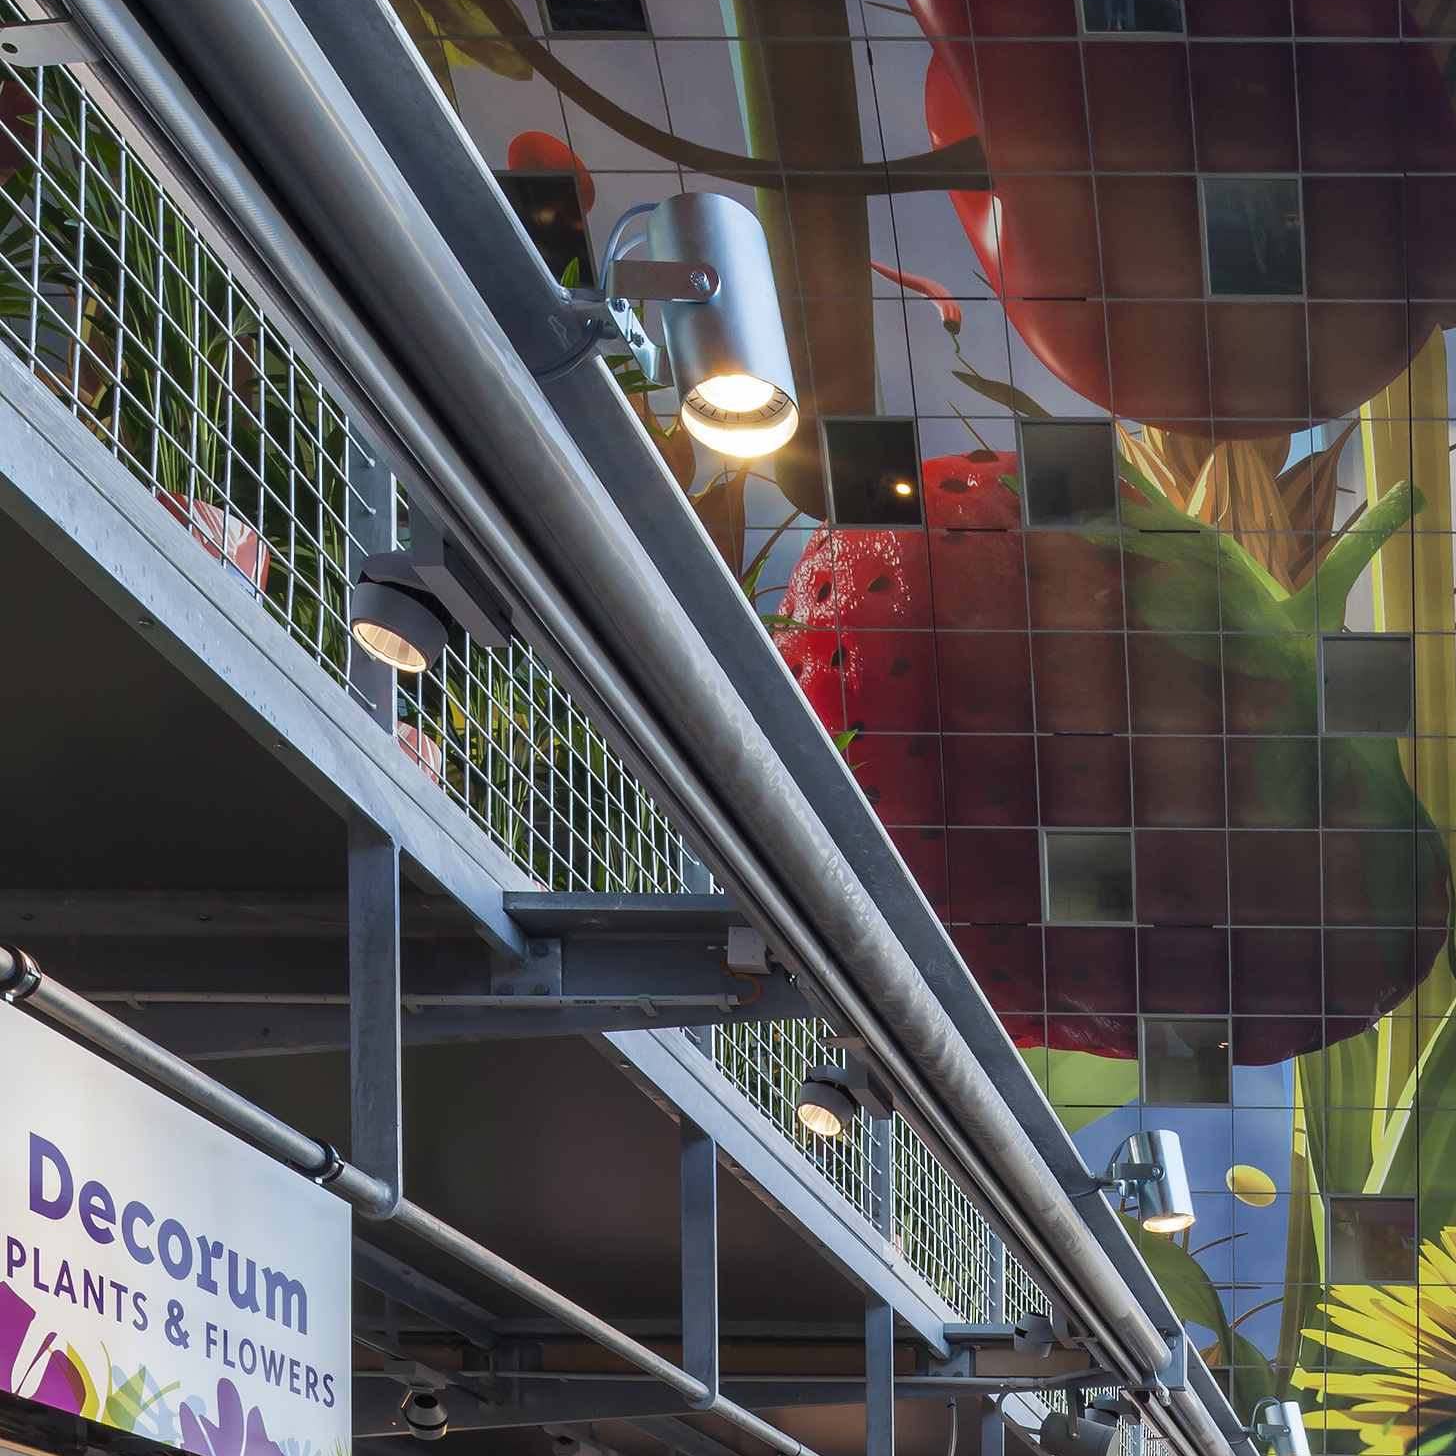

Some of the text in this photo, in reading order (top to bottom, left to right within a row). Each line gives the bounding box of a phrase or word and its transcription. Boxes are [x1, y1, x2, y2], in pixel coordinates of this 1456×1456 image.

[6, 1235, 335, 1409] PLANTS & FLOWERS
[29, 1131, 308, 1336] Decorum
